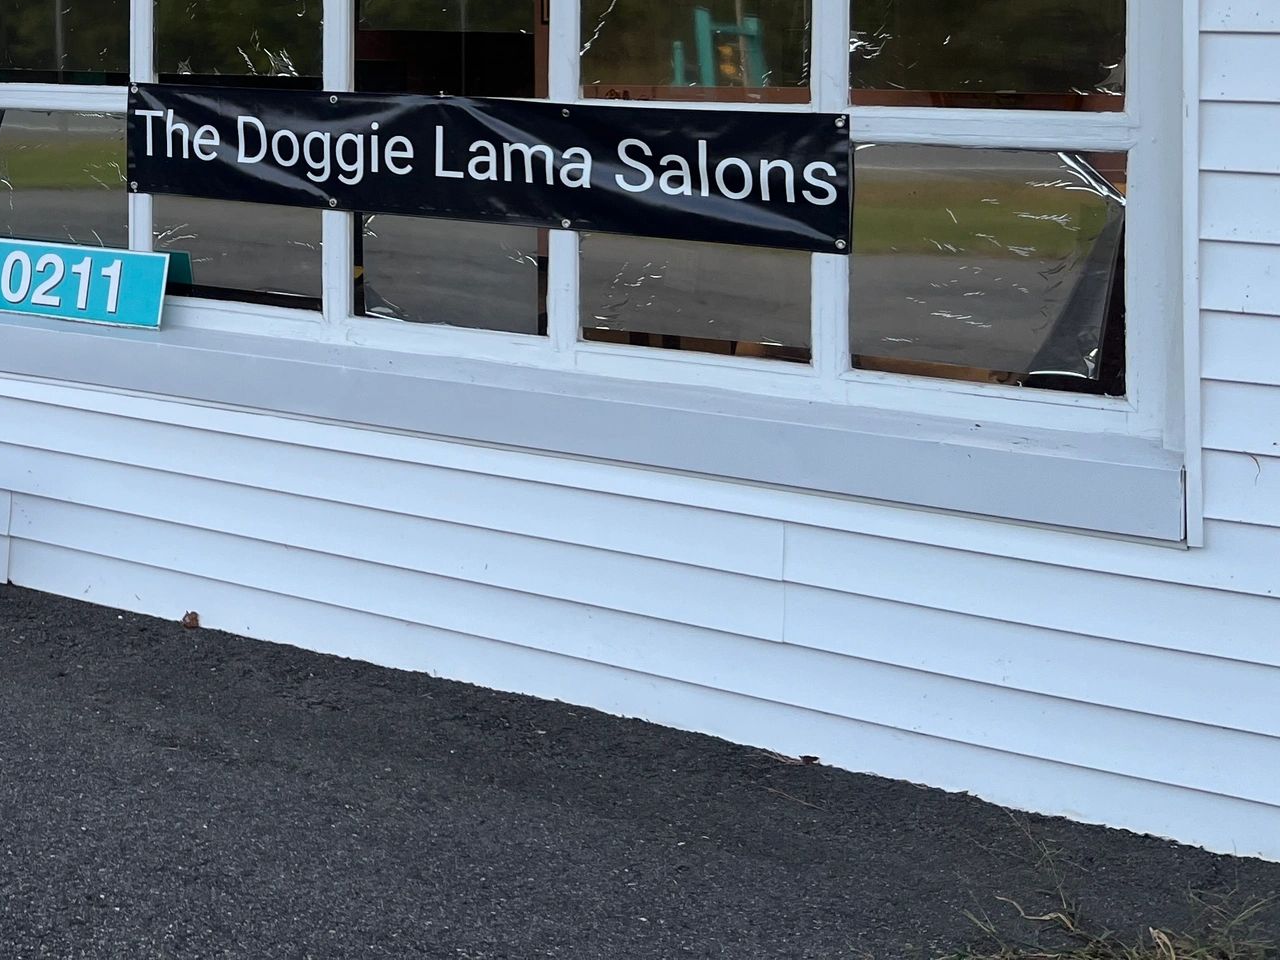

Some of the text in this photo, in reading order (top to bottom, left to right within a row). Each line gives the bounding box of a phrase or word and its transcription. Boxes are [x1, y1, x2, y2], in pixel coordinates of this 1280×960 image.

[134, 108, 839, 206] The Doggie Lama Salons
